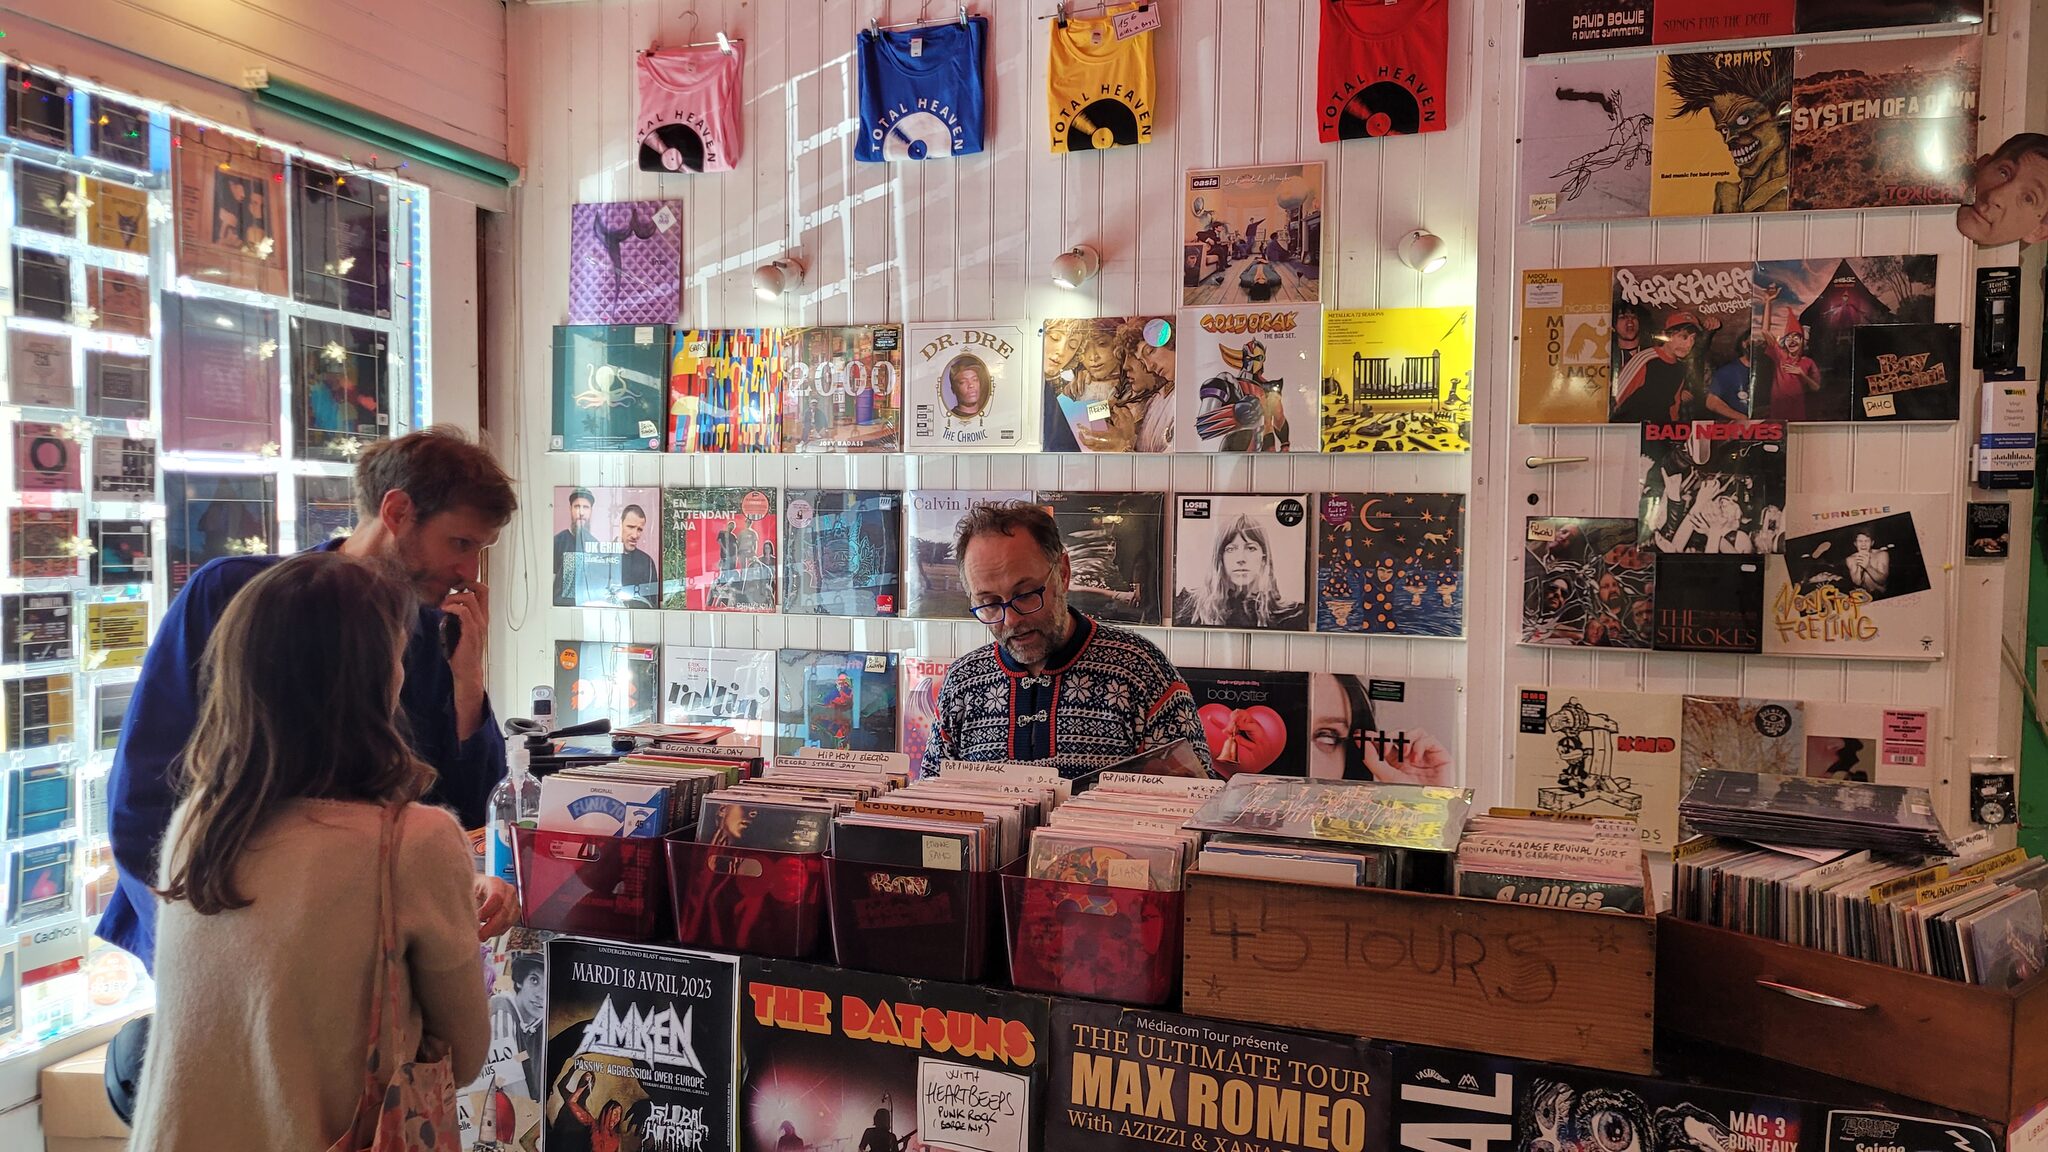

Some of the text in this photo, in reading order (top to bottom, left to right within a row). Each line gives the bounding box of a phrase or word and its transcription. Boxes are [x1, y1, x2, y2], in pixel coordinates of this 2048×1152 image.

[1572, 9, 1645, 29] DAVID BOWIE
[1663, 18, 1696, 32] SONGS
[1722, 14, 1741, 28] THE
[1572, 25, 1645, 40] A DIVINE SYMMETRY
[1714, 50, 1772, 69] CRAMPS
[1322, 65, 1437, 132] TOTAL HEAVEN
[1053, 83, 1152, 146] TOTAL HEAVEN
[1794, 91, 1976, 131] SYSTEM OF A DWN
[872, 98, 964, 153] TOTAL HEAVEN
[675, 110, 717, 163] HEAVEN
[1193, 177, 1218, 187] oasis
[1710, 171, 1730, 179] people
[1718, 297, 1752, 314] togethe
[1200, 310, 1299, 335] GOLDORAK
[919, 331, 959, 362] DR.
[963, 330, 1015, 361] DRE
[785, 360, 897, 397] 2000
[1567, 365, 1610, 379] MOC
[942, 426, 955, 442] THE
[957, 429, 988, 443] CHRONIC
[1645, 424, 1783, 440] BAD NERVES
[673, 498, 687, 507] EN
[914, 497, 961, 511] Calvin
[672, 509, 737, 520] ATTENDANT
[1812, 505, 1890, 521] TURNSTILE
[672, 521, 696, 532] ANA
[585, 542, 625, 554] UK GRIM
[1617, 736, 1676, 753] KMD
[835, 752, 850, 761] HOP
[572, 796, 608, 817] FUNK
[33, 924, 78, 944] Cadhoc
[598, 947, 659, 960] UNDERGROUND BLAST
[1208, 894, 1558, 1005] 45 TOURS
[572, 962, 712, 999] MARDI 18 AVRIL 2023
[749, 982, 1036, 1067] THE DATSUNS
[573, 992, 708, 1078] AMKEN
[1136, 1016, 1289, 1054] Médiacom Tour présente
[1072, 1023, 1372, 1097] THE ULTIMATE TOUR
[574, 1058, 705, 1089] PASSIVE AGGRESSION OVER EUROPE
[945, 1070, 980, 1083] WITH
[926, 1081, 1015, 1116] HEARTBEEPS
[1071, 1052, 1366, 1152] MAX ROMEO
[937, 1106, 998, 1123] PUNK ROCK
[1730, 1110, 1786, 1138] MAC 3
[1067, 1109, 1113, 1134] With
[1119, 1119, 1186, 1148] AZIZZI
[1191, 1133, 1208, 1151] &
[1728, 1133, 1799, 1152] BORDEAUX
